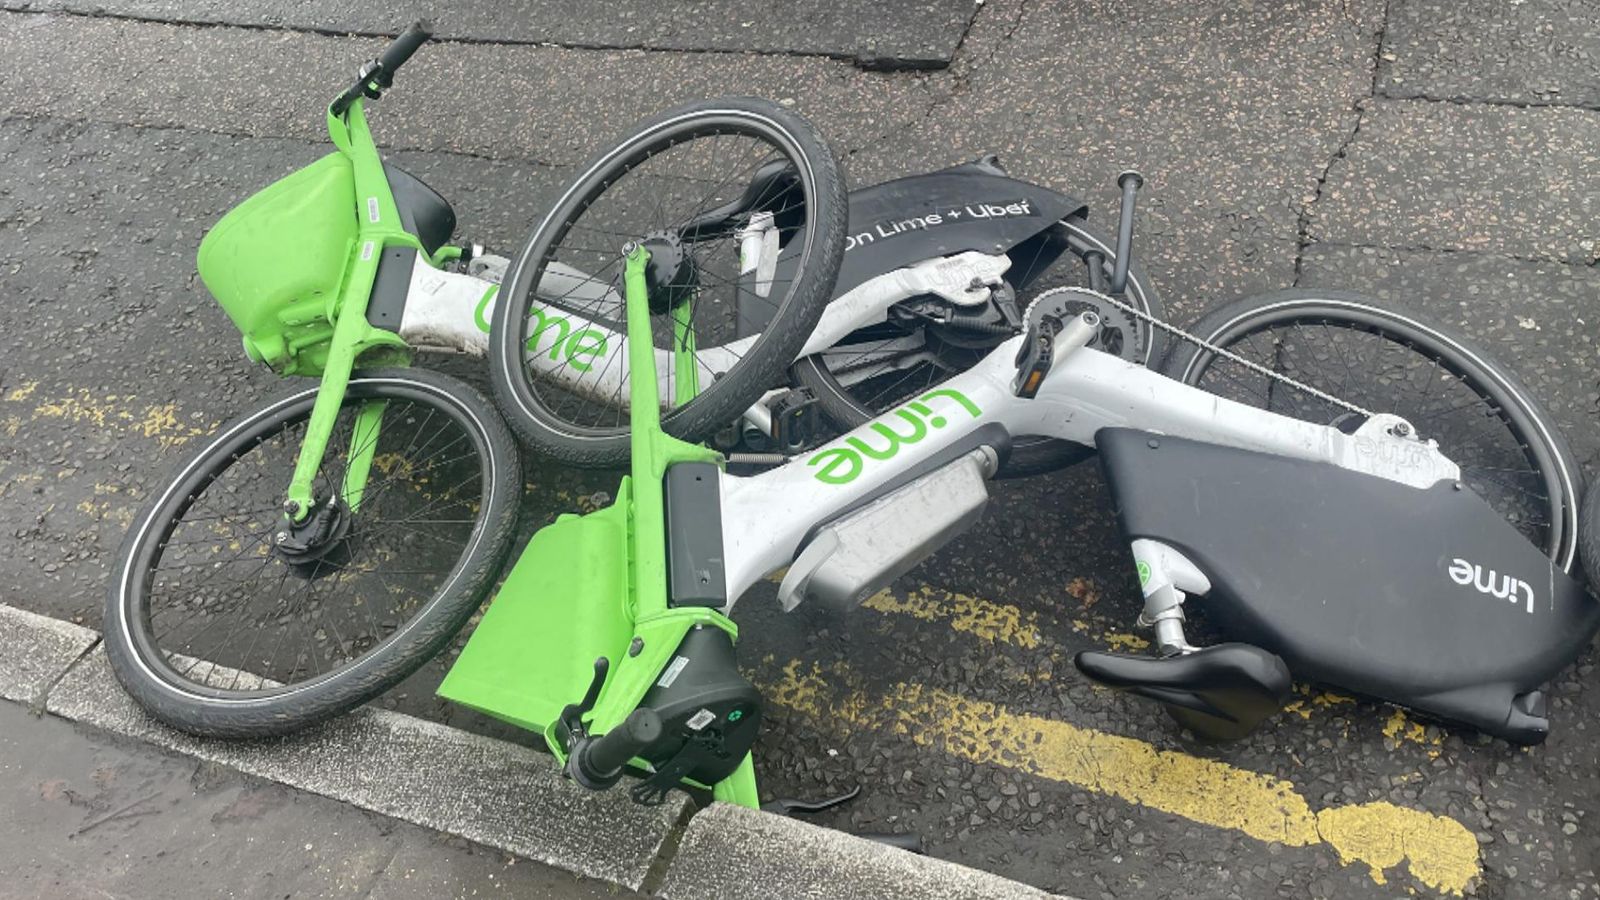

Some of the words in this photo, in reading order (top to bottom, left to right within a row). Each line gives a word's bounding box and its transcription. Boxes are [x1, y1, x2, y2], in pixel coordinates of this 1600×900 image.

[876, 213, 943, 238] Lime
[965, 200, 1031, 218] Uber
[807, 389, 982, 484] Lime
[1449, 558, 1534, 613] Lime
